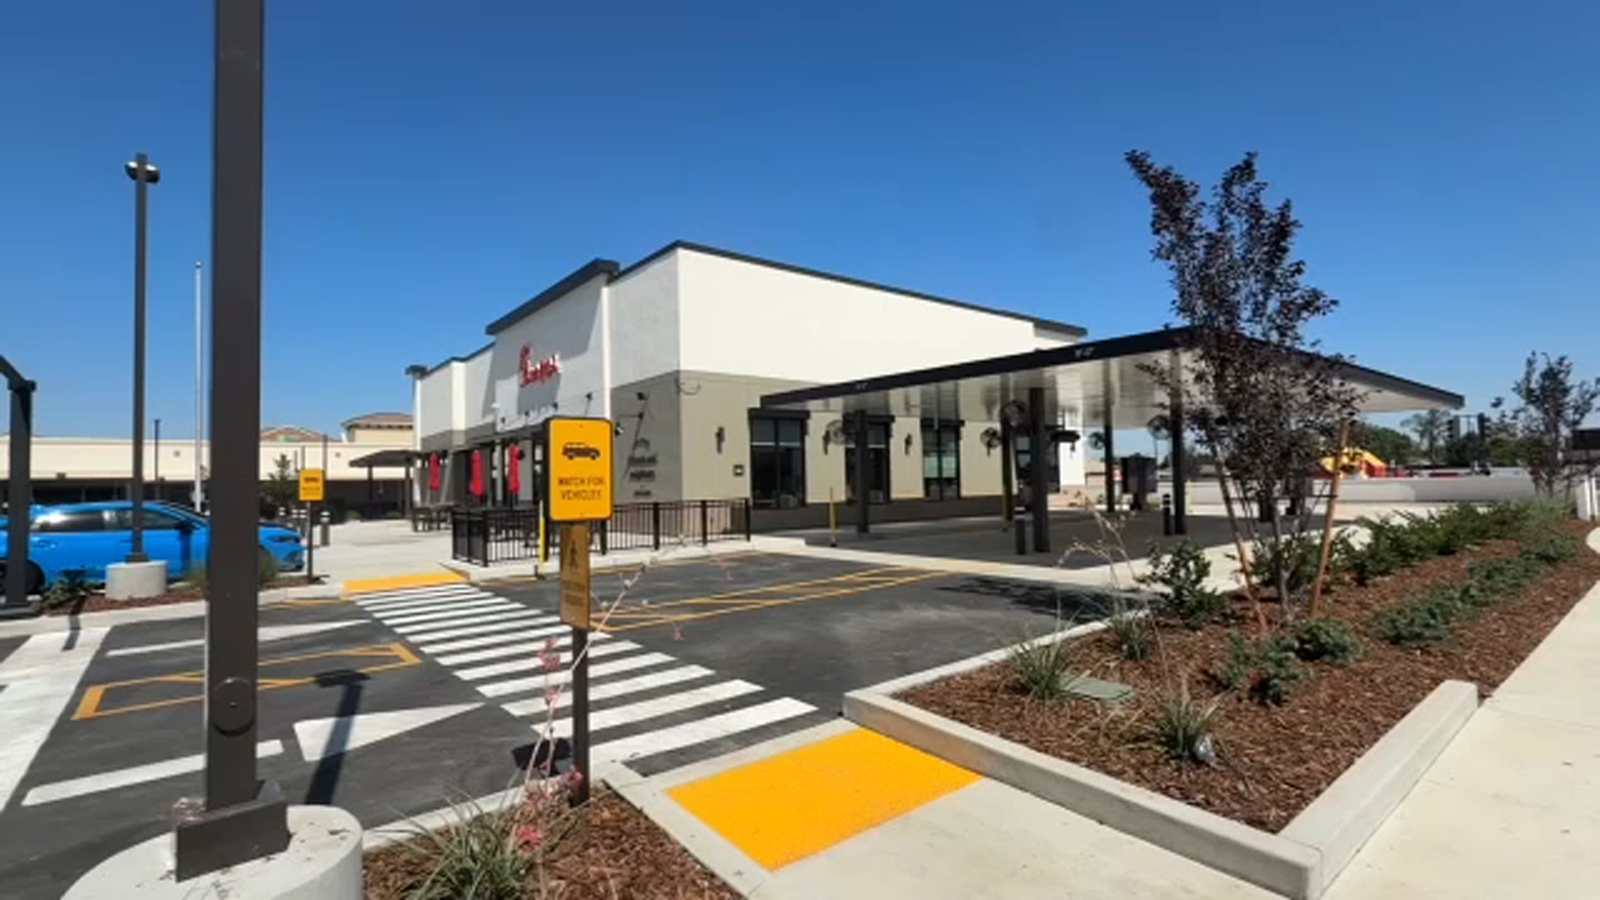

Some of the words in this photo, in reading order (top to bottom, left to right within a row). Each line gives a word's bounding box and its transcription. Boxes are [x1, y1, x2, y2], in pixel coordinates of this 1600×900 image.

[559, 476, 586, 486] WATCH
[587, 475, 605, 486] FOR
[560, 489, 602, 501] VEHICLES
